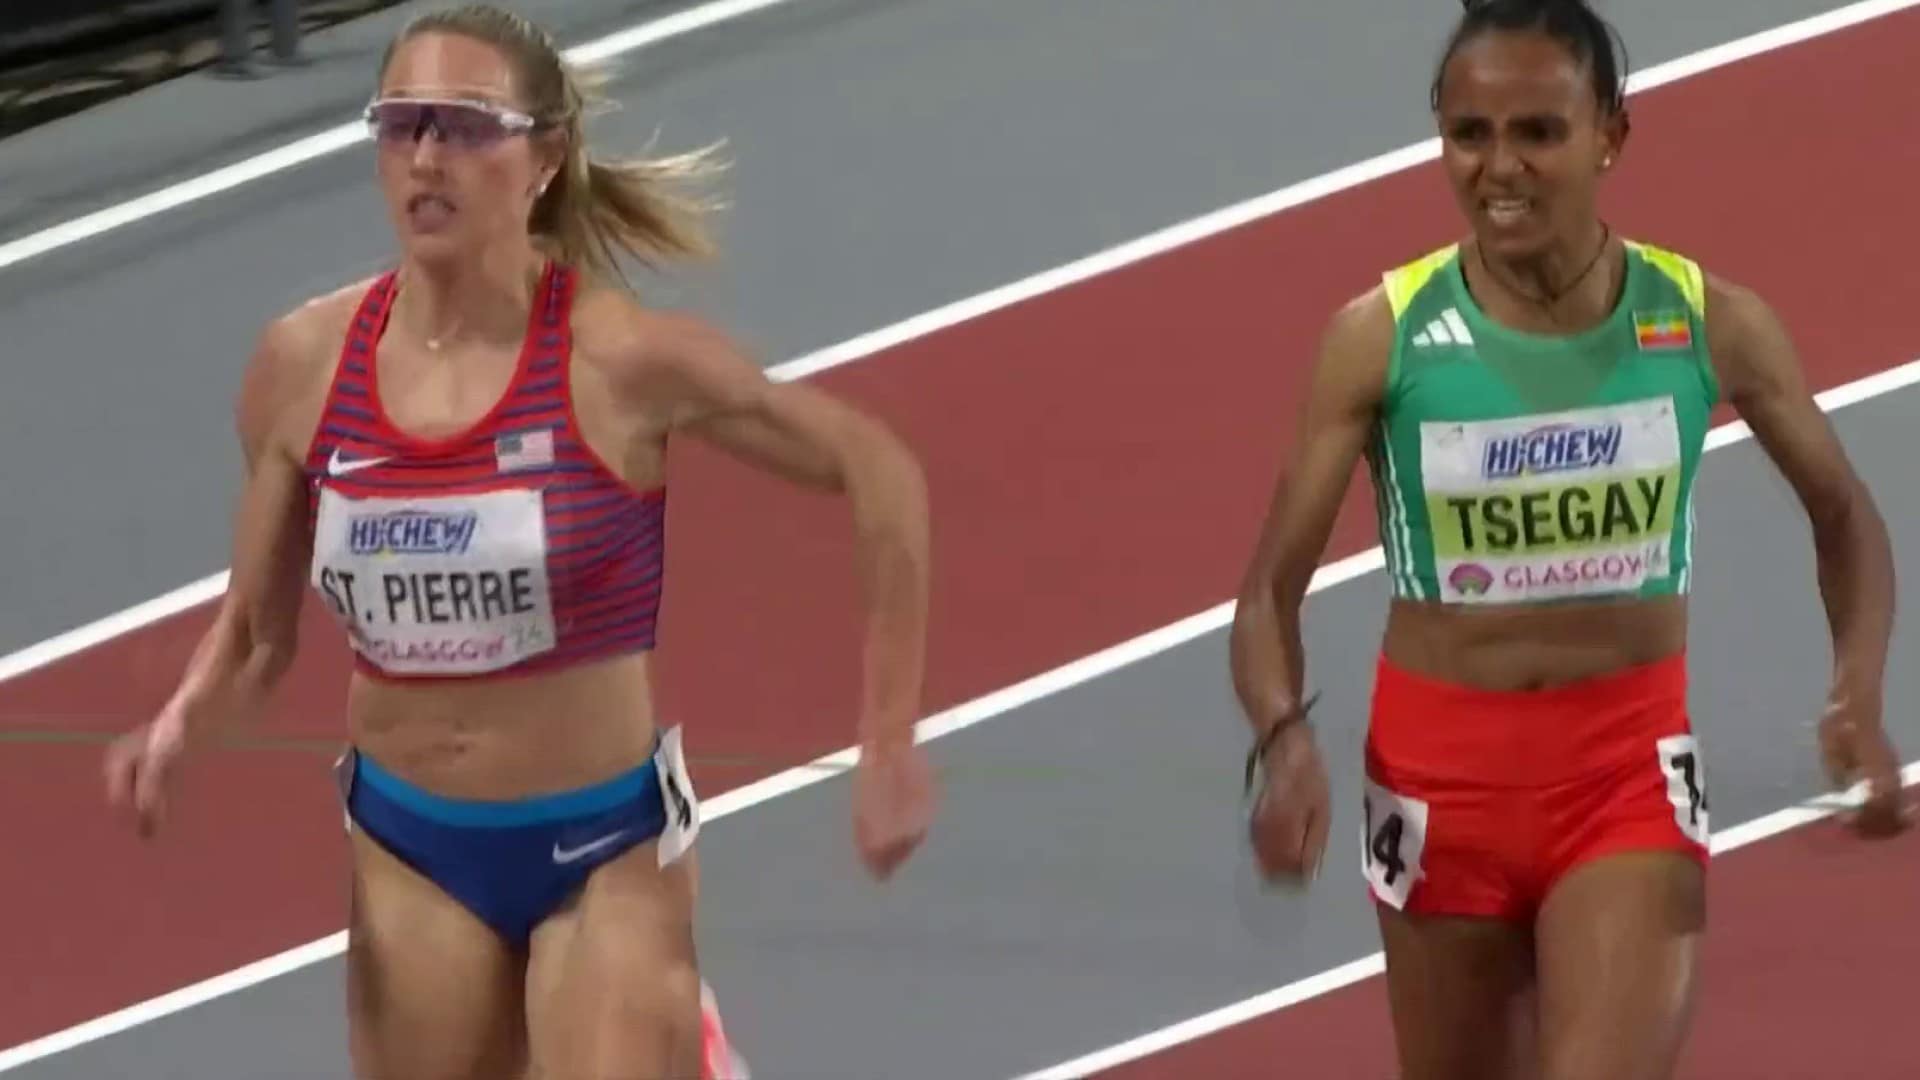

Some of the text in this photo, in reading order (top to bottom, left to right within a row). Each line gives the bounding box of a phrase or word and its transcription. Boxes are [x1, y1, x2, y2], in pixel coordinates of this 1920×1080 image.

[1446, 474, 1666, 552] TSEGAY
[321, 566, 535, 624] ST. PIERRE
[1363, 795, 1406, 887] 14
